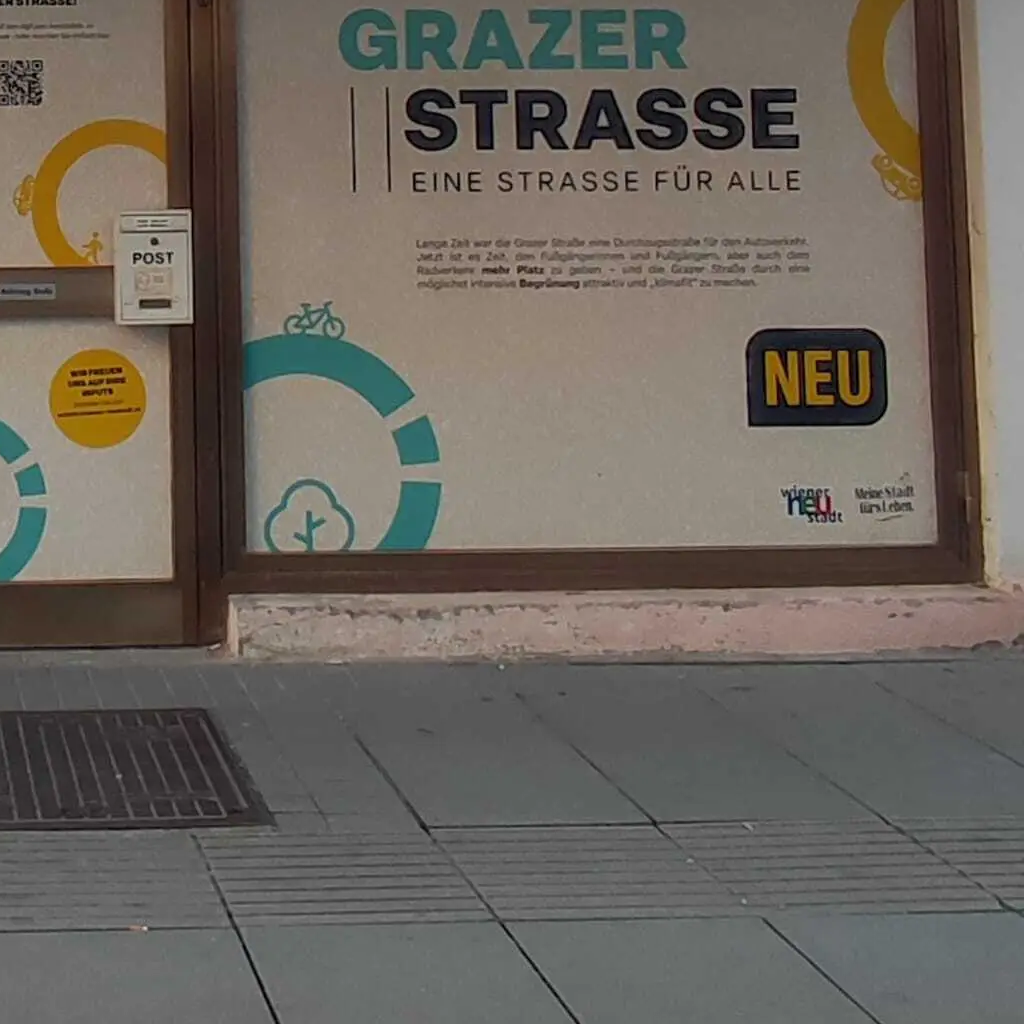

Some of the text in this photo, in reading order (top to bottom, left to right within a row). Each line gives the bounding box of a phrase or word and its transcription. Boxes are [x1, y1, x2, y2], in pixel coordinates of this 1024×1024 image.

[338, 7, 689, 72] GRAZER
[403, 87, 801, 152] STRASSE
[411, 164, 802, 193] EINE STRASSE FÜR ALLE
[131, 251, 175, 265] POST
[763, 349, 872, 407] NEU
[780, 485, 830, 498] wiener
[885, 485, 915, 497] Stadt
[787, 494, 833, 516] neu
[807, 511, 843, 524] stadt
